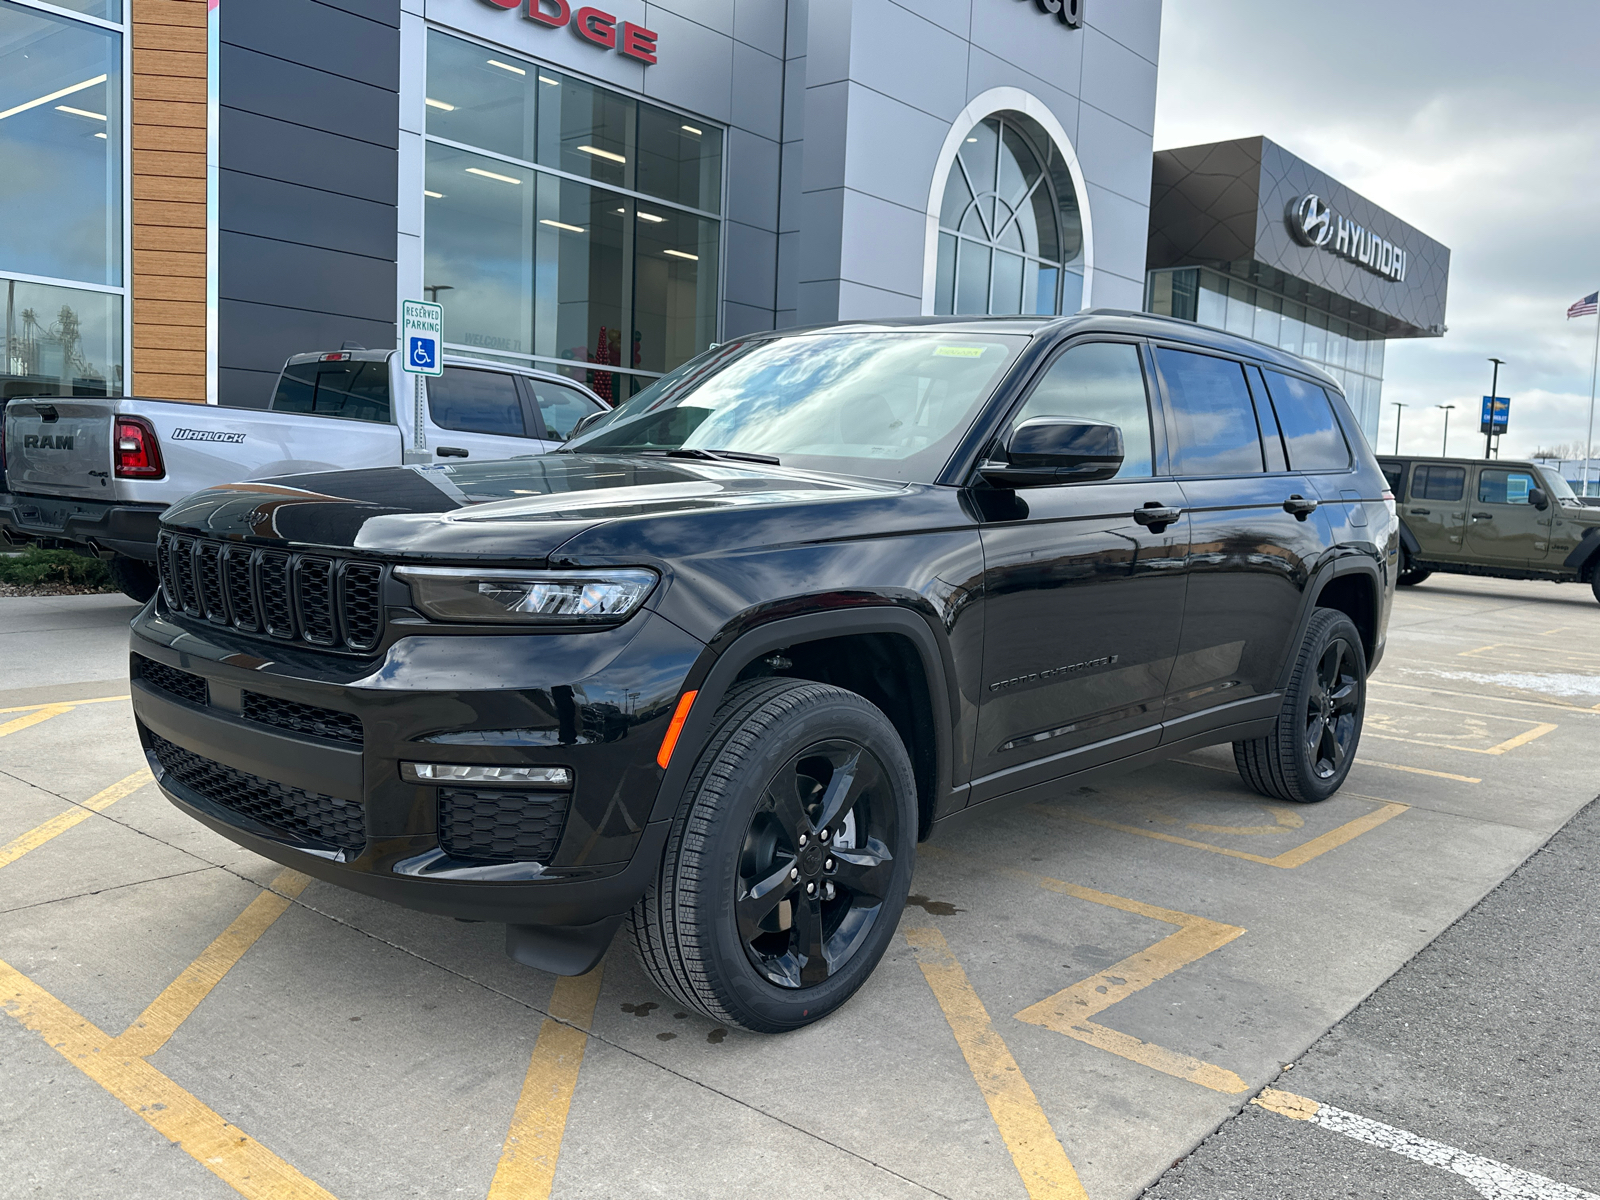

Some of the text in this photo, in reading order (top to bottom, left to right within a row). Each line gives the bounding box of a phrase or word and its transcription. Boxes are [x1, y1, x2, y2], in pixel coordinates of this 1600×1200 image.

[482, 0, 658, 64] DGE
[1335, 214, 1407, 283] HYUNDAI
[405, 305, 440, 321] RESERVED
[405, 318, 440, 333] PARKING
[464, 332, 511, 350] WELCOME
[23, 434, 74, 450] RAM
[171, 427, 247, 444] WARLOCK
[1551, 543, 1570, 551] Jeep
[1039, 656, 1108, 680] CHEROKEE
